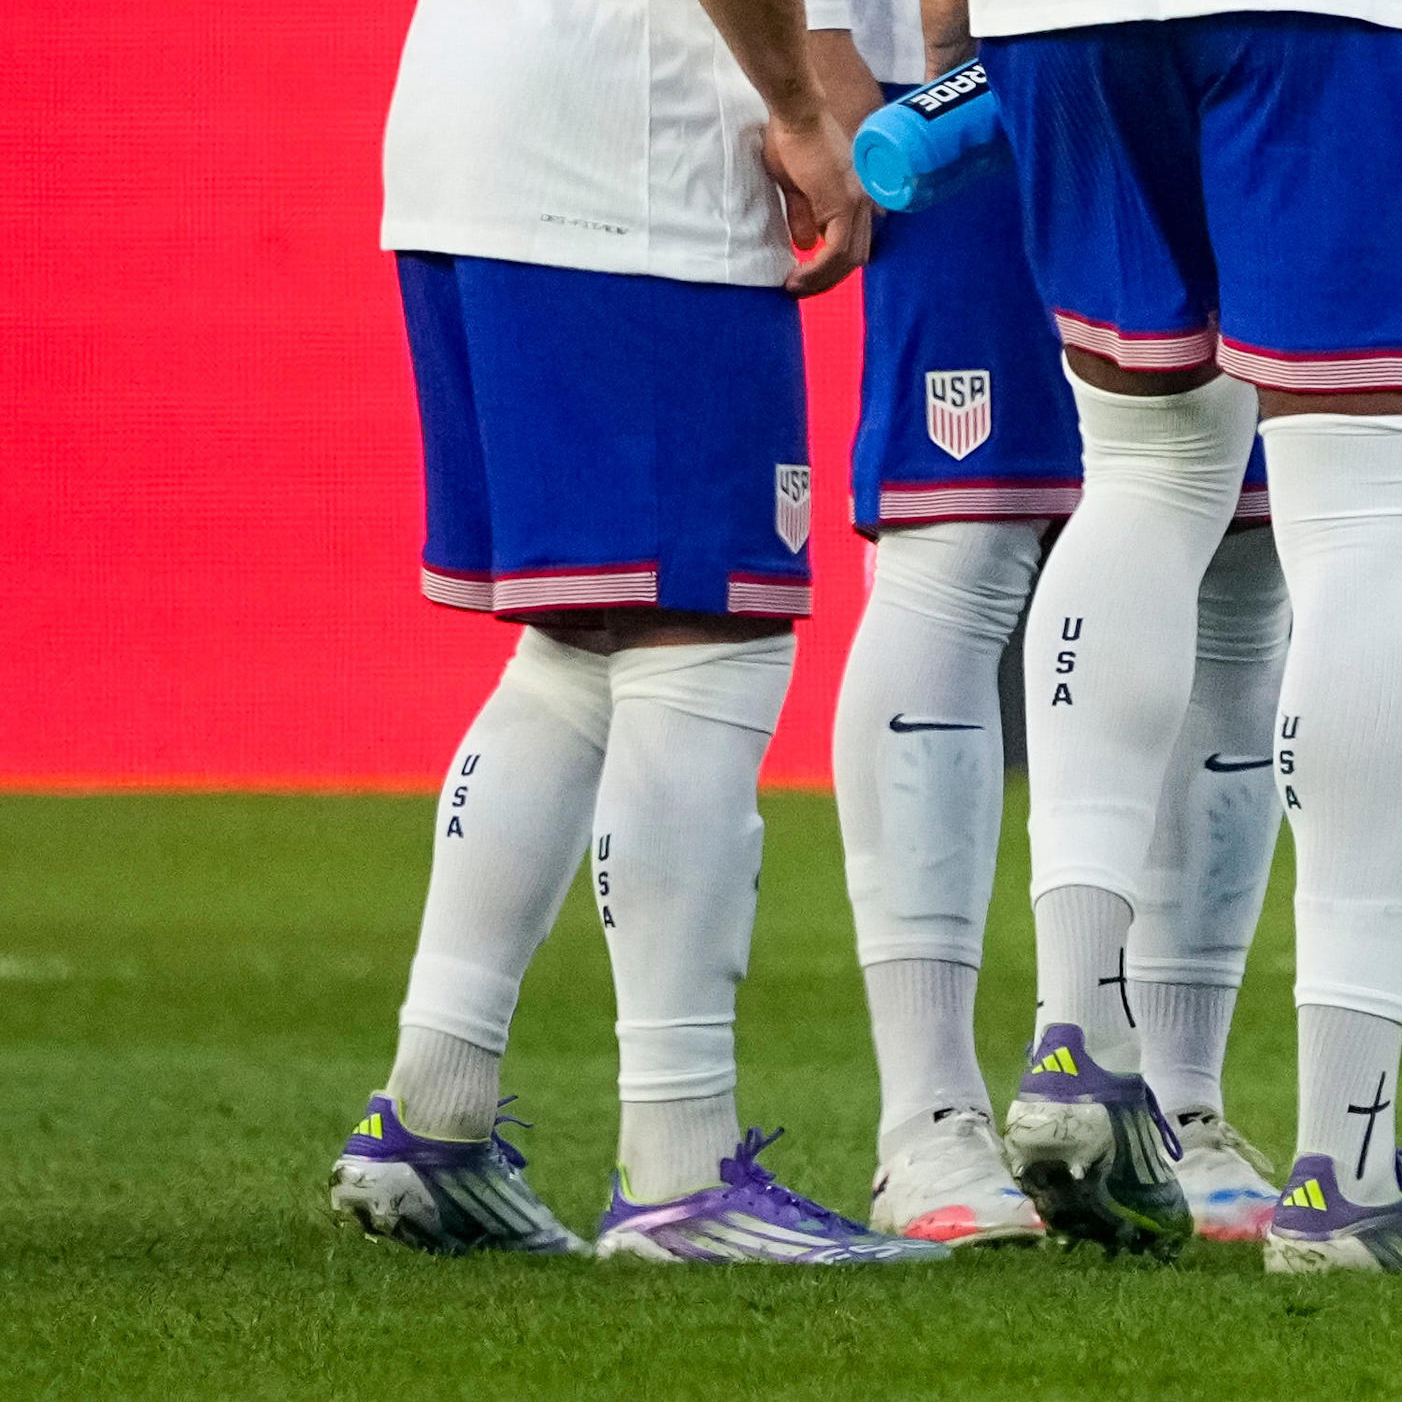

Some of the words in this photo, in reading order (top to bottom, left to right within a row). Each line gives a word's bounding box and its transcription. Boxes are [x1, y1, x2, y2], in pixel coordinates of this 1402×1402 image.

[931, 376, 985, 407] USA
[1052, 617, 1083, 706] USA
[446, 754, 480, 839] USA
[1279, 712, 1302, 811] USA
[598, 834, 616, 929] USA
